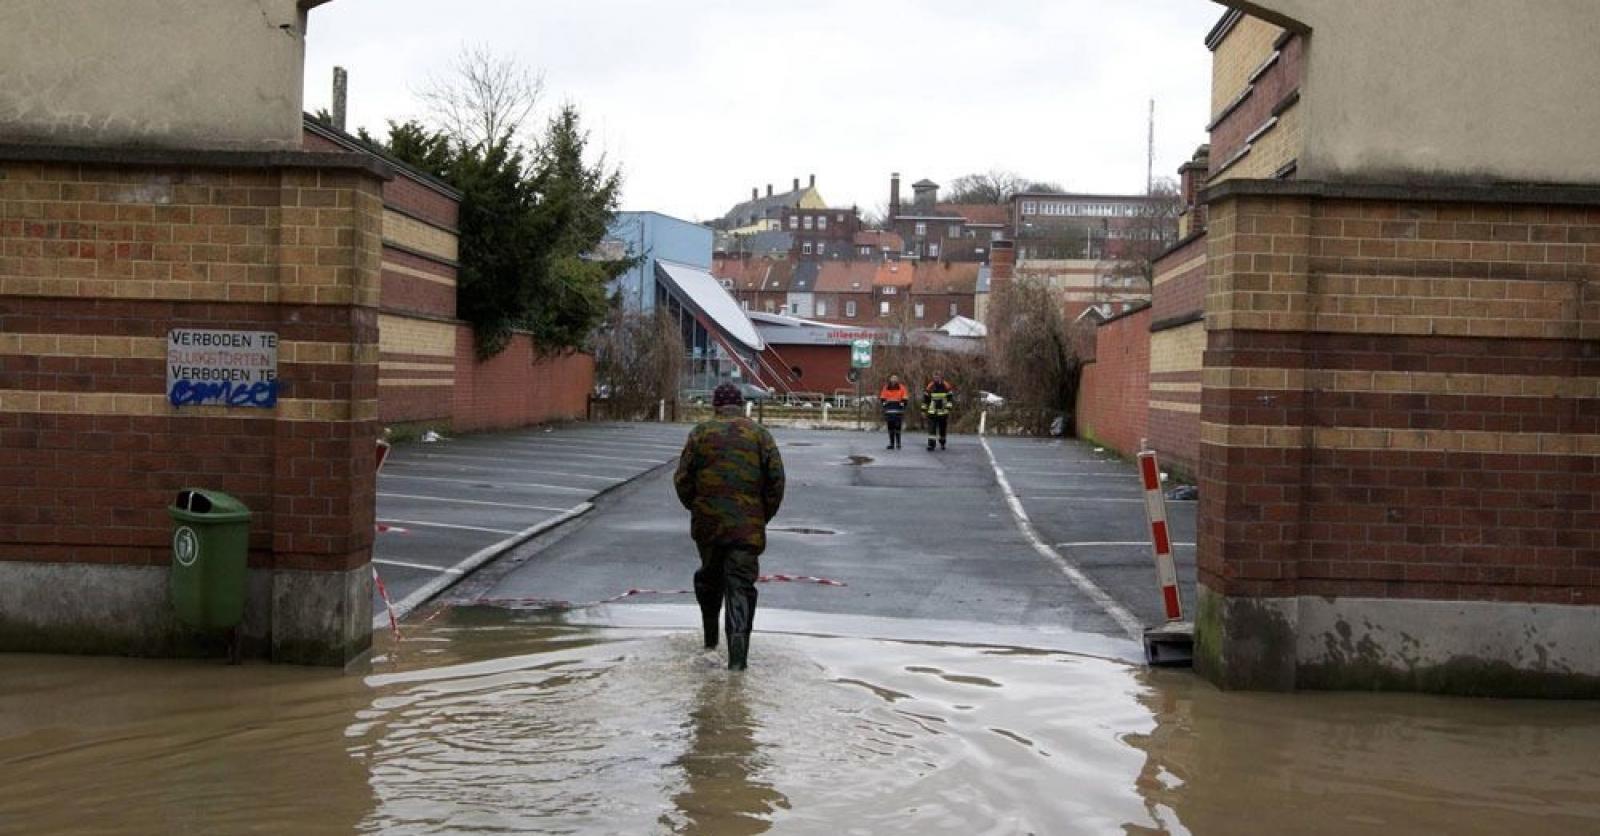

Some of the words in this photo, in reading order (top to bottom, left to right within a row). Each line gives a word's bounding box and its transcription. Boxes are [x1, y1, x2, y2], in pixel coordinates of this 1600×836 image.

[171, 331, 251, 347] VERBODEN
[259, 335, 277, 348] TE
[171, 365, 251, 381] VERBODEN
[258, 369, 276, 382] TE
